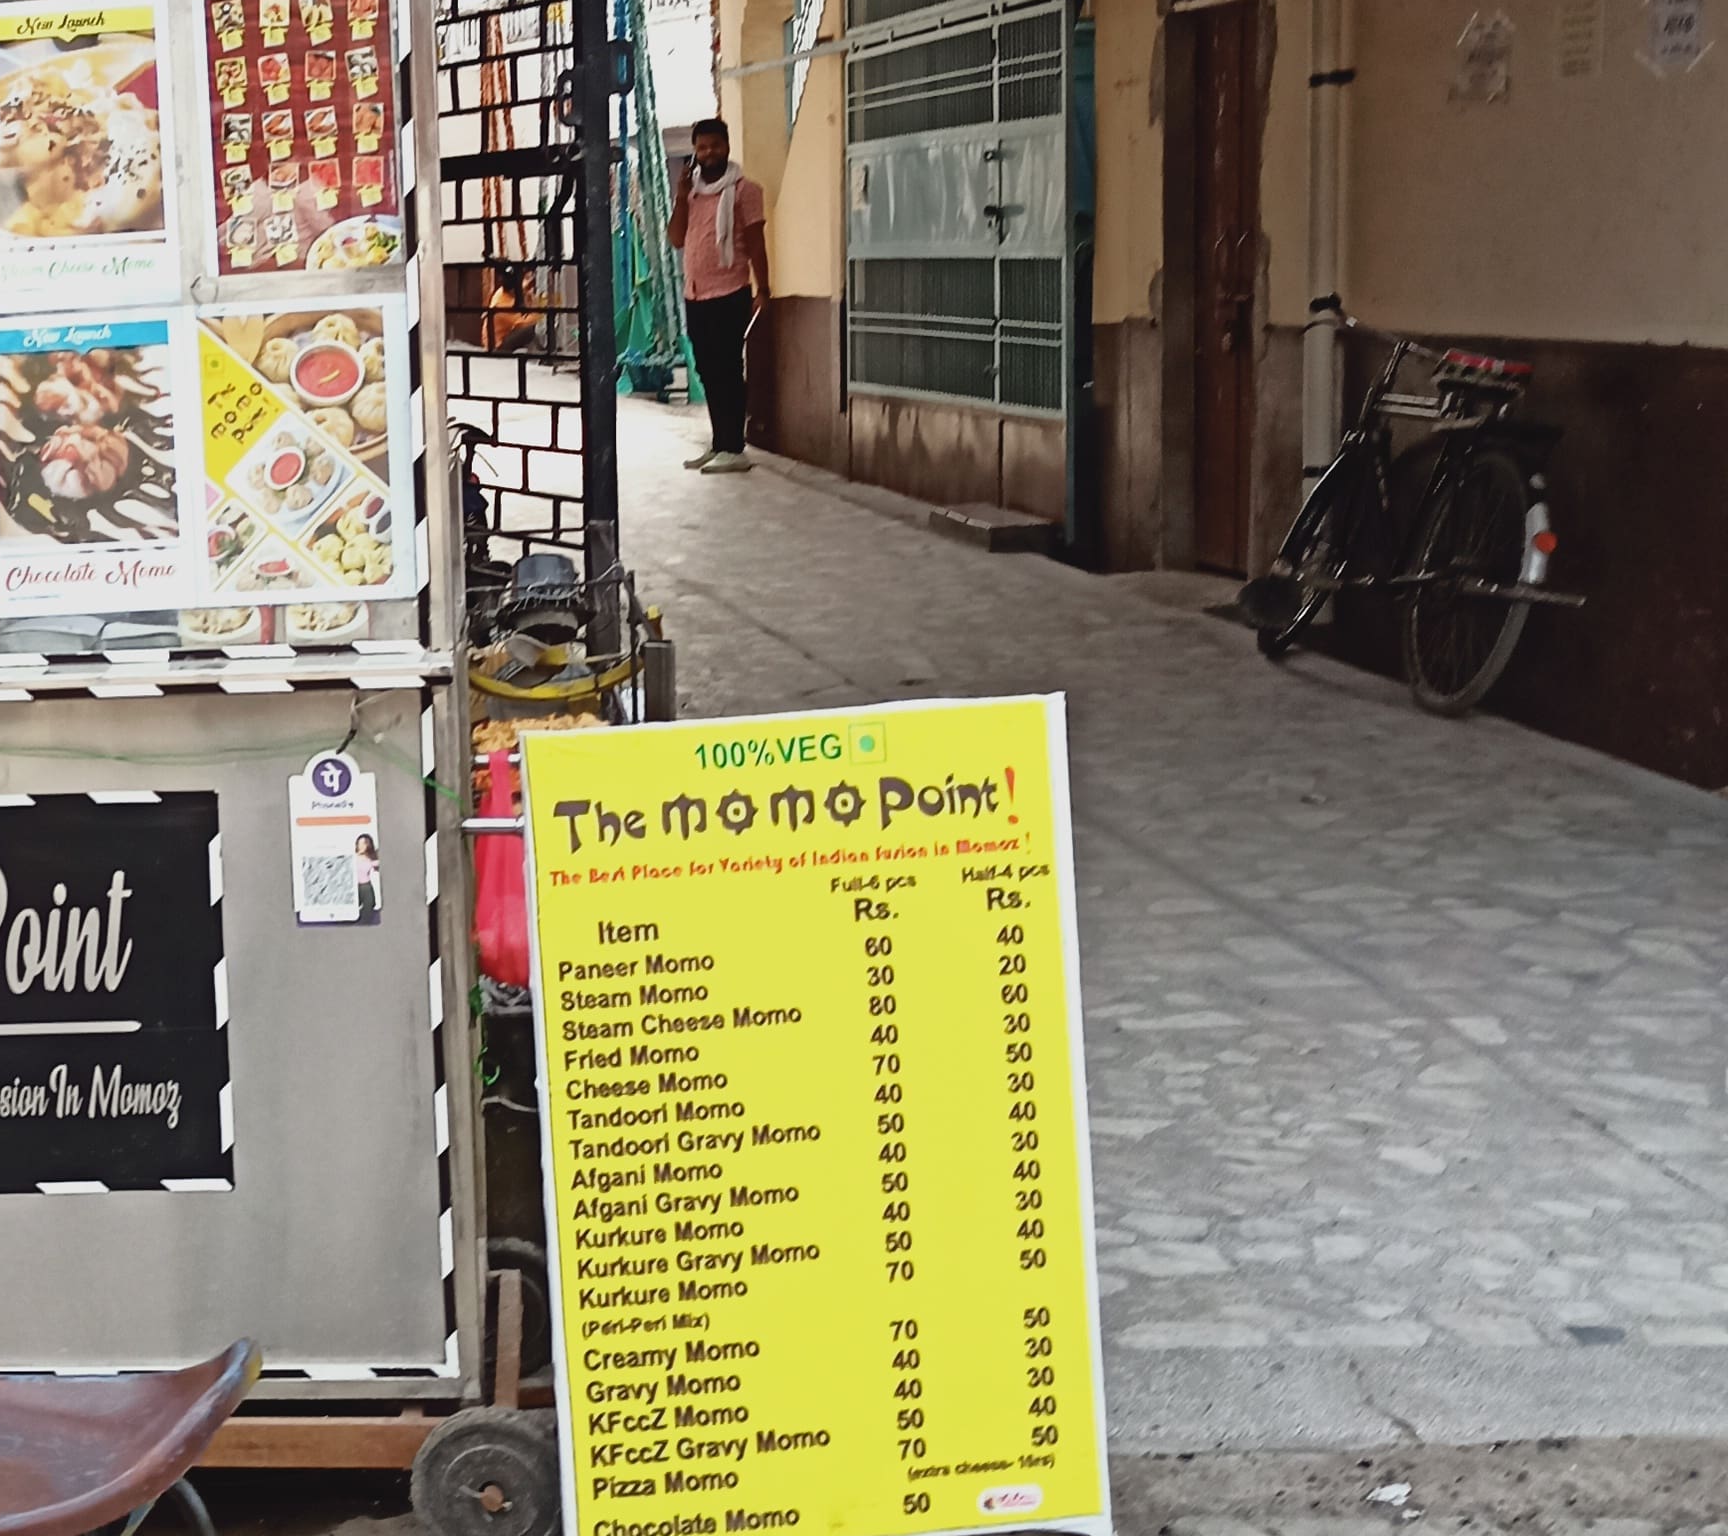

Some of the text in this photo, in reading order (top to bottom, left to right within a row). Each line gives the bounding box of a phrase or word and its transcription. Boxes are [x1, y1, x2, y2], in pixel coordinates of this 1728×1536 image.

[5, 559, 177, 592] Chocolate Momo
[553, 799, 647, 854] The
[598, 921, 659, 945] Item
[996, 924, 1024, 946] 40
[558, 953, 715, 982] Paneer Momo
[998, 953, 1027, 976] 20
[560, 984, 709, 1012] Steam Momo
[869, 994, 897, 1017] 80
[562, 1006, 802, 1042] Steam Cheese Momo
[870, 1024, 899, 1046] 40
[564, 1045, 700, 1072] Fried Momo
[1006, 1041, 1033, 1064] 50
[872, 1053, 901, 1076] 70
[48, 1064, 82, 1117] In
[87, 1064, 182, 1128] Momoz
[566, 1071, 728, 1100] Cheese Momo
[874, 1083, 903, 1105] 40
[566, 1100, 745, 1130] Tandoori Momo
[1008, 1100, 1037, 1122] 40
[877, 1112, 905, 1135] 50
[568, 1123, 821, 1160] Tandoori Gravy Momo
[878, 1142, 907, 1163] 40
[571, 1162, 723, 1194] Afgani Momo
[1012, 1159, 1041, 1182] 40
[881, 1171, 909, 1194] 50
[573, 1185, 800, 1224] Afgani Gravy Momo
[882, 1201, 911, 1223] 40
[575, 1220, 745, 1250] Kurkure Momo
[1016, 1218, 1045, 1240] 40
[885, 1230, 913, 1253] 50
[577, 1243, 820, 1280] Kurkure Gravy Momo
[1019, 1248, 1047, 1271] 50
[886, 1260, 915, 1283] 70
[579, 1280, 748, 1310] Kurkure Momo
[1023, 1306, 1051, 1329] 50
[889, 1319, 919, 1342] 70
[583, 1339, 761, 1372] Creamy Momo
[892, 1348, 921, 1371] 40
[585, 1373, 741, 1406] Gravy Momo
[893, 1378, 923, 1401] 40
[674, 1404, 749, 1429] Momo
[1028, 1395, 1057, 1418] 40
[897, 1407, 925, 1431] 50
[676, 1437, 749, 1462] Gravy
[756, 1429, 831, 1453] Momo
[1031, 1424, 1059, 1447] 50
[897, 1437, 927, 1461] 70
[592, 1470, 739, 1501] Pizza Momo
[903, 1492, 931, 1515] 50
[725, 1508, 800, 1533] Momo
